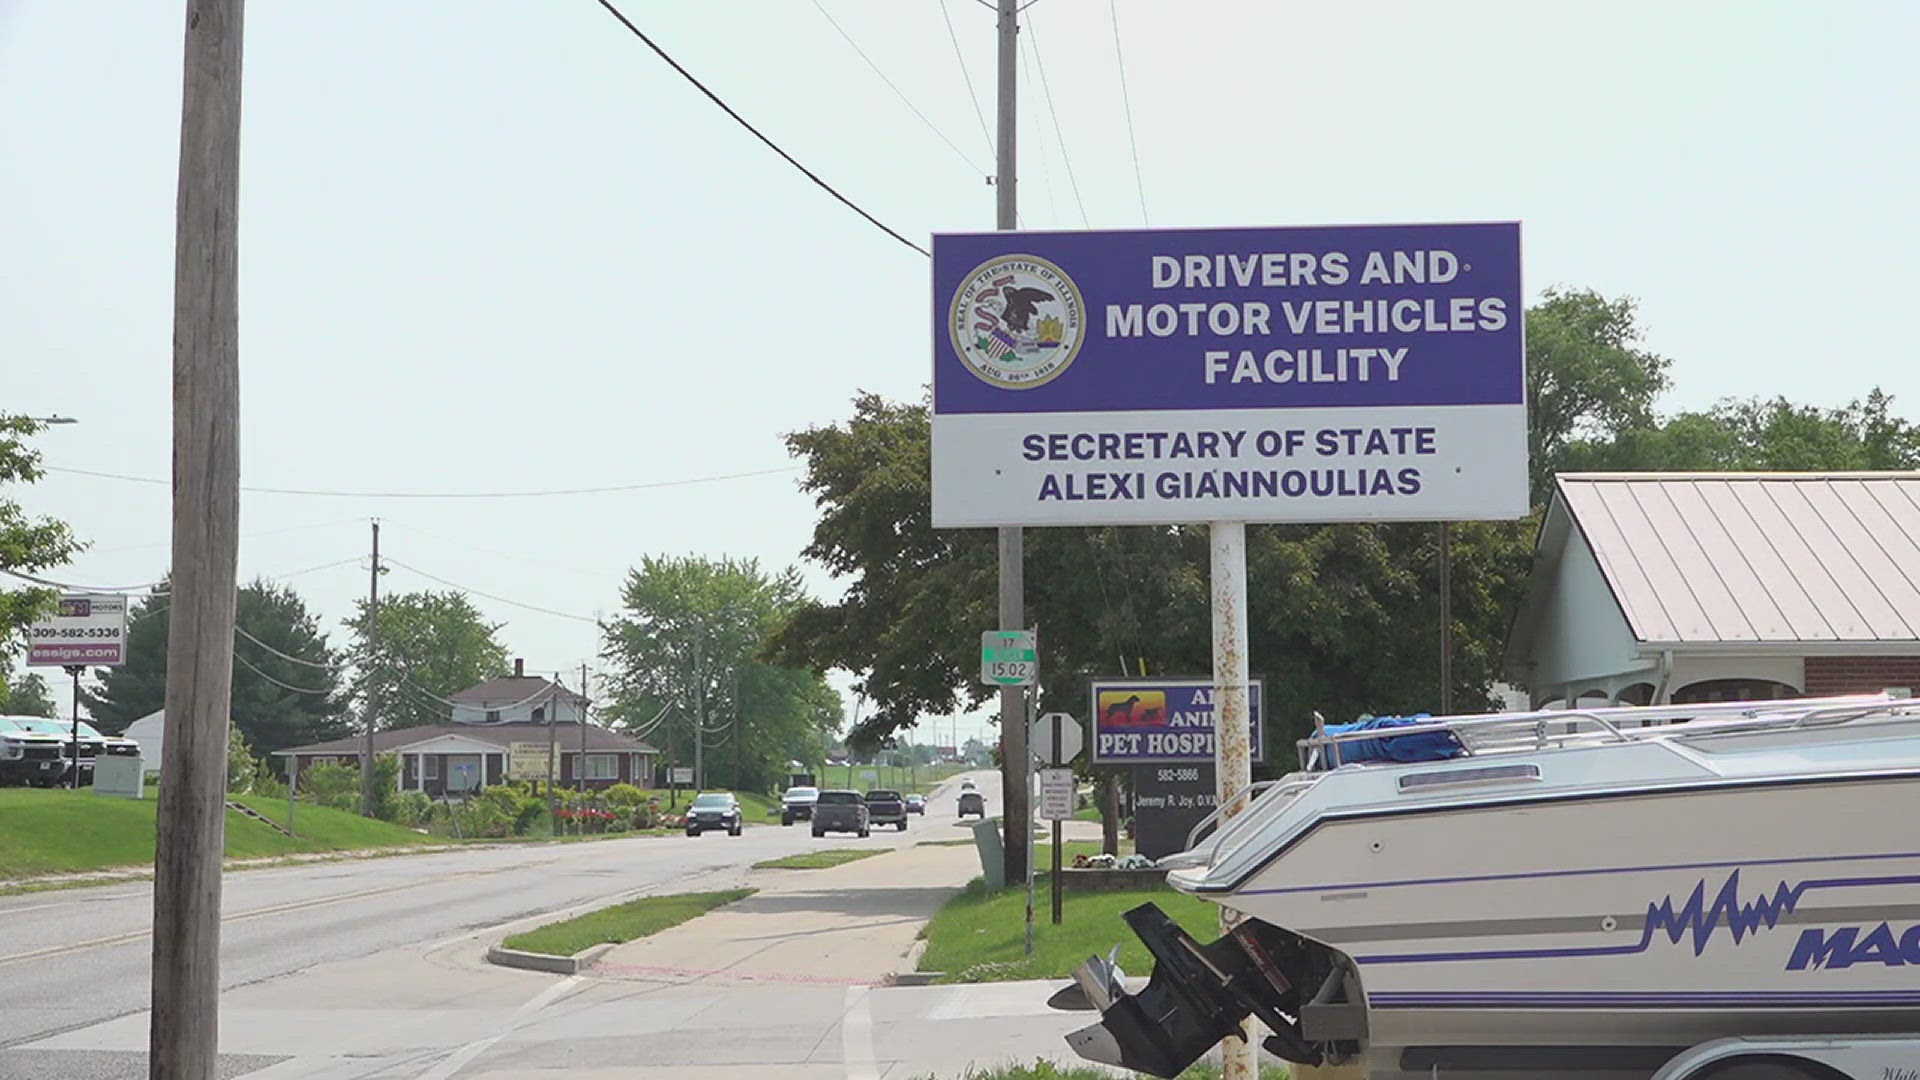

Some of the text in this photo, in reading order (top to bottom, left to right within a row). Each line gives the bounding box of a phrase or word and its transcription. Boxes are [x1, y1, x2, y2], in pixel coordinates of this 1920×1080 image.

[1151, 250, 1459, 288] DRIVERS AND
[958, 262, 1077, 330] SEAL OF THE STATE OF ILLINOIS
[1106, 297, 1508, 338] MOTOR VEHICLES
[1204, 347, 1409, 384] FACILITY
[1022, 426, 1437, 462] SECRETARY OF STATE
[1037, 467, 1422, 501] ALEXI GIANNOULIAS
[32, 628, 120, 638] 309-582-5336
[1002, 637, 1015, 648] 17
[33, 648, 118, 660] essigs.com
[1100, 733, 1142, 755] PET
[1136, 795, 1166, 809] Jeremy
